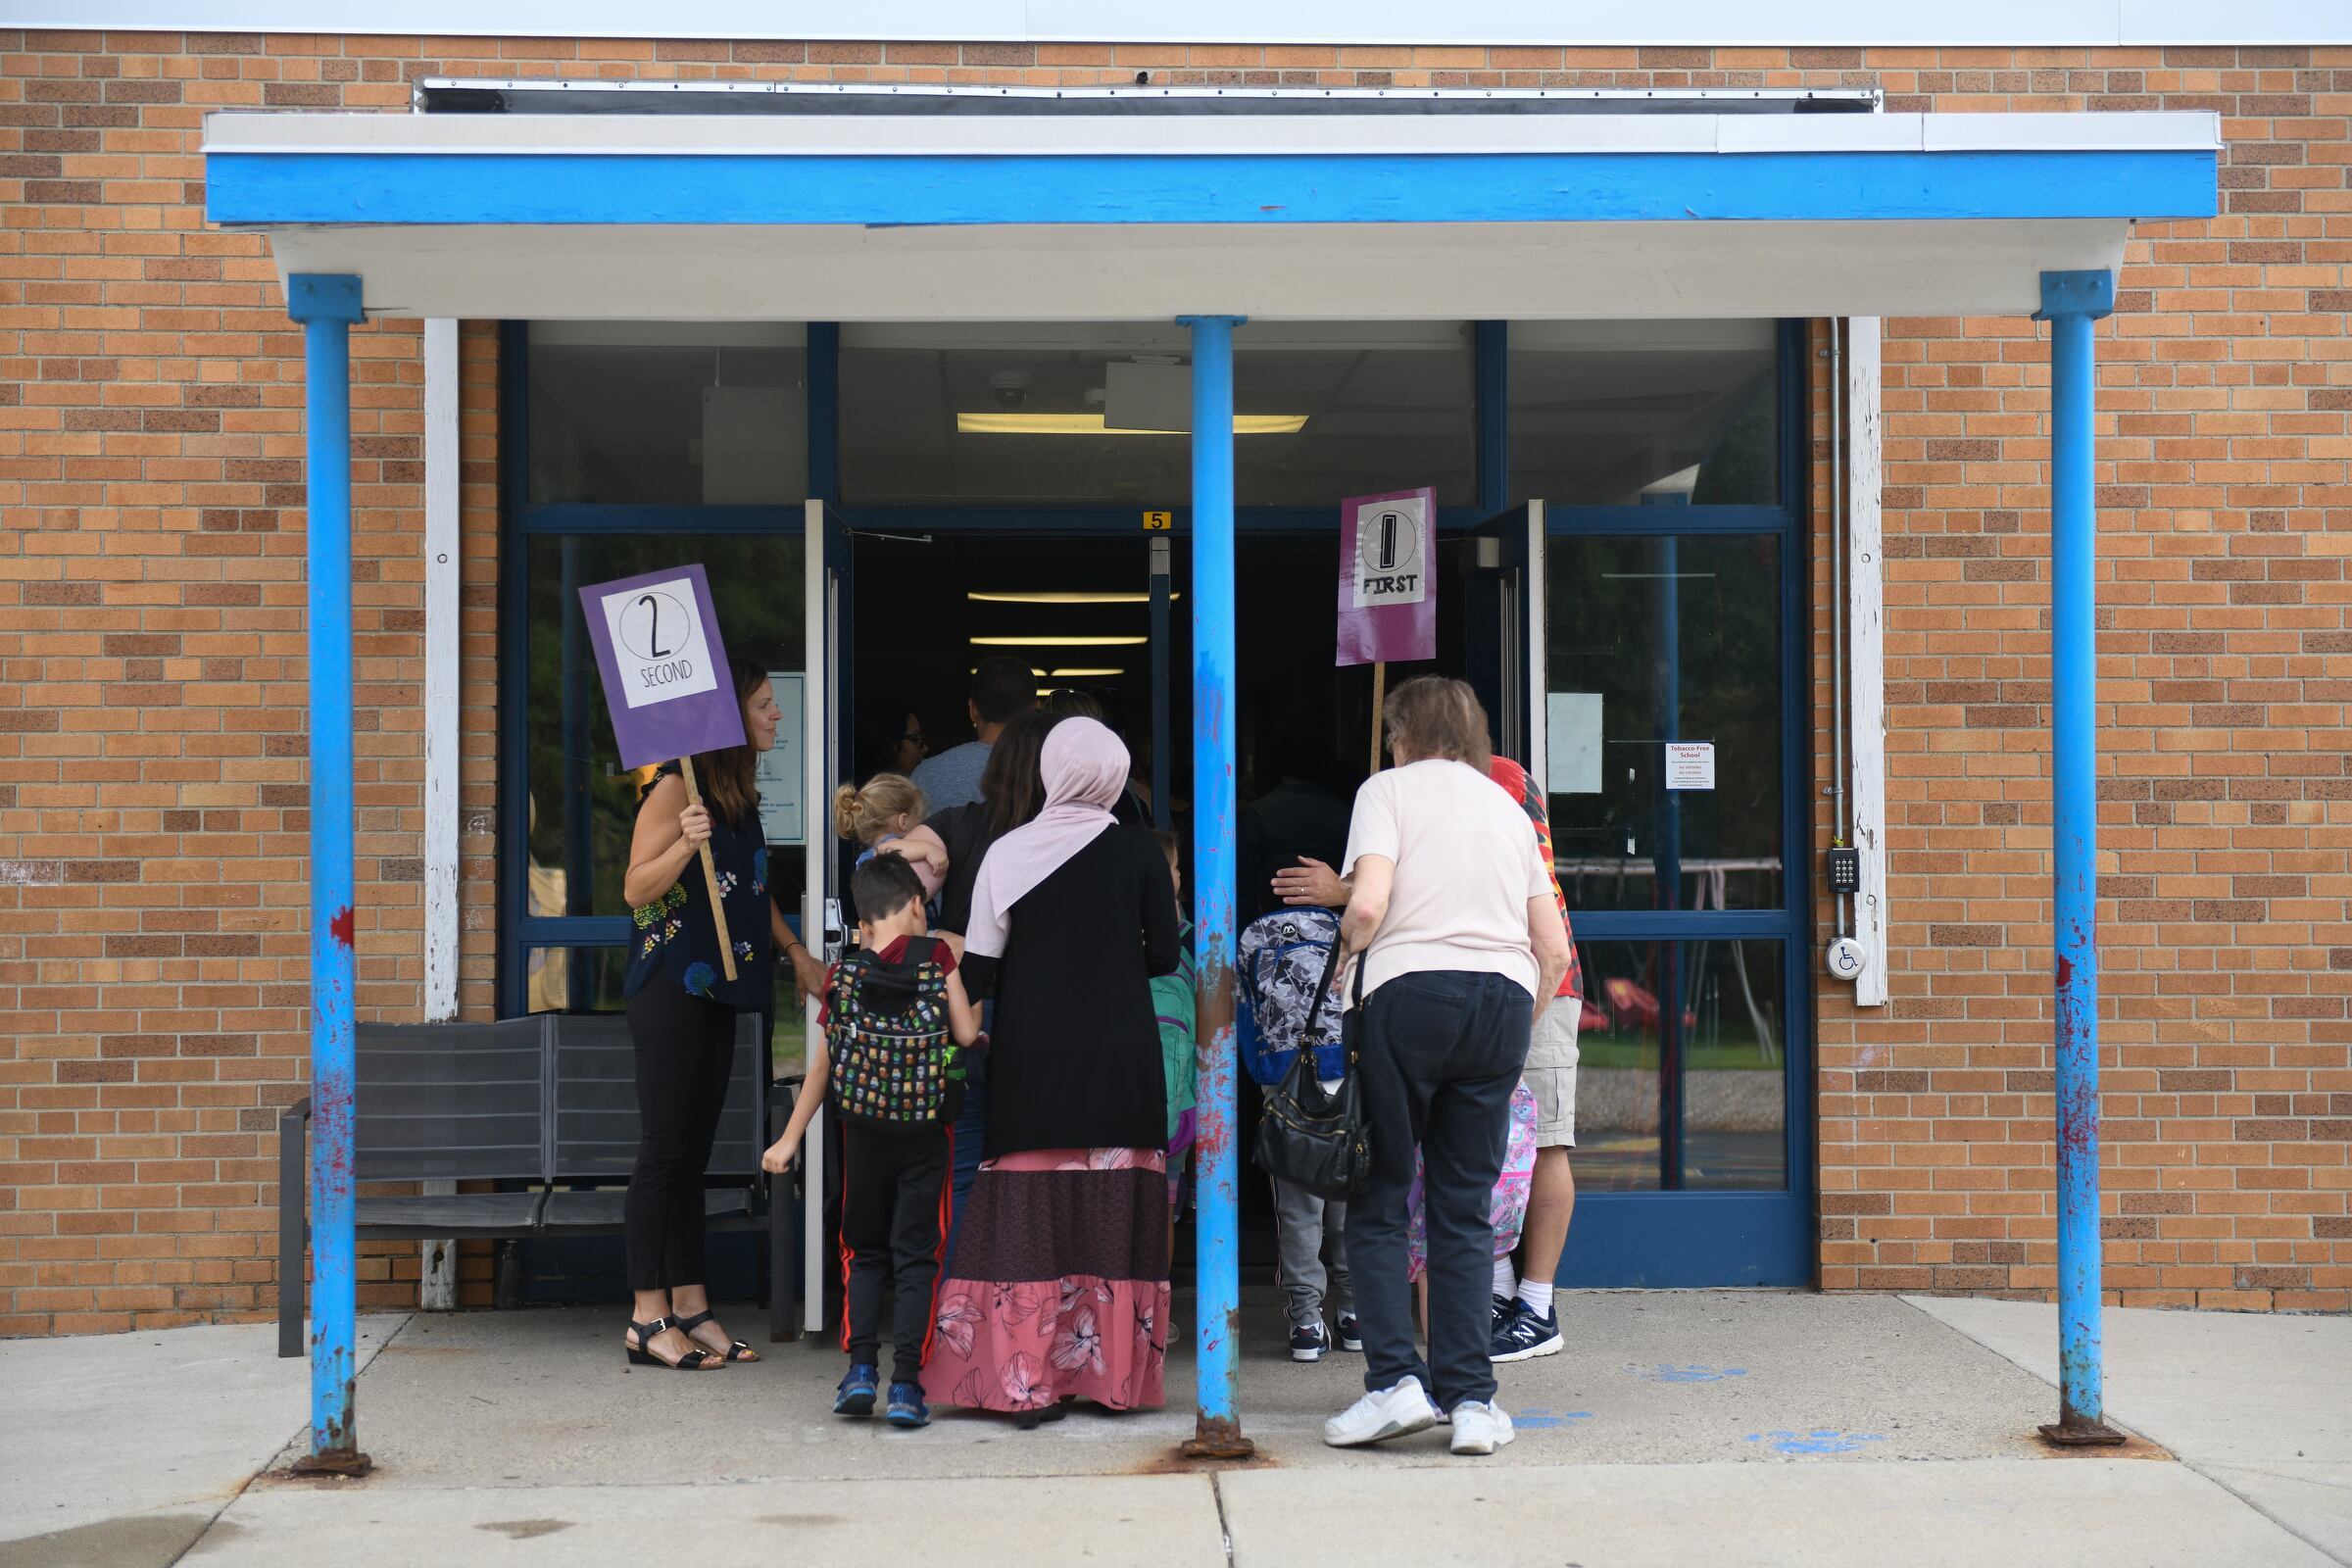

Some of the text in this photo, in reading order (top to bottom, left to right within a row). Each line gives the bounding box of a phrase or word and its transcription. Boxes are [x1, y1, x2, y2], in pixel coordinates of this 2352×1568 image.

[1152, 513, 1163, 528] 5
[1363, 574, 1418, 596] FIRST
[639, 595, 671, 659] 2
[641, 660, 693, 688] SECOND
